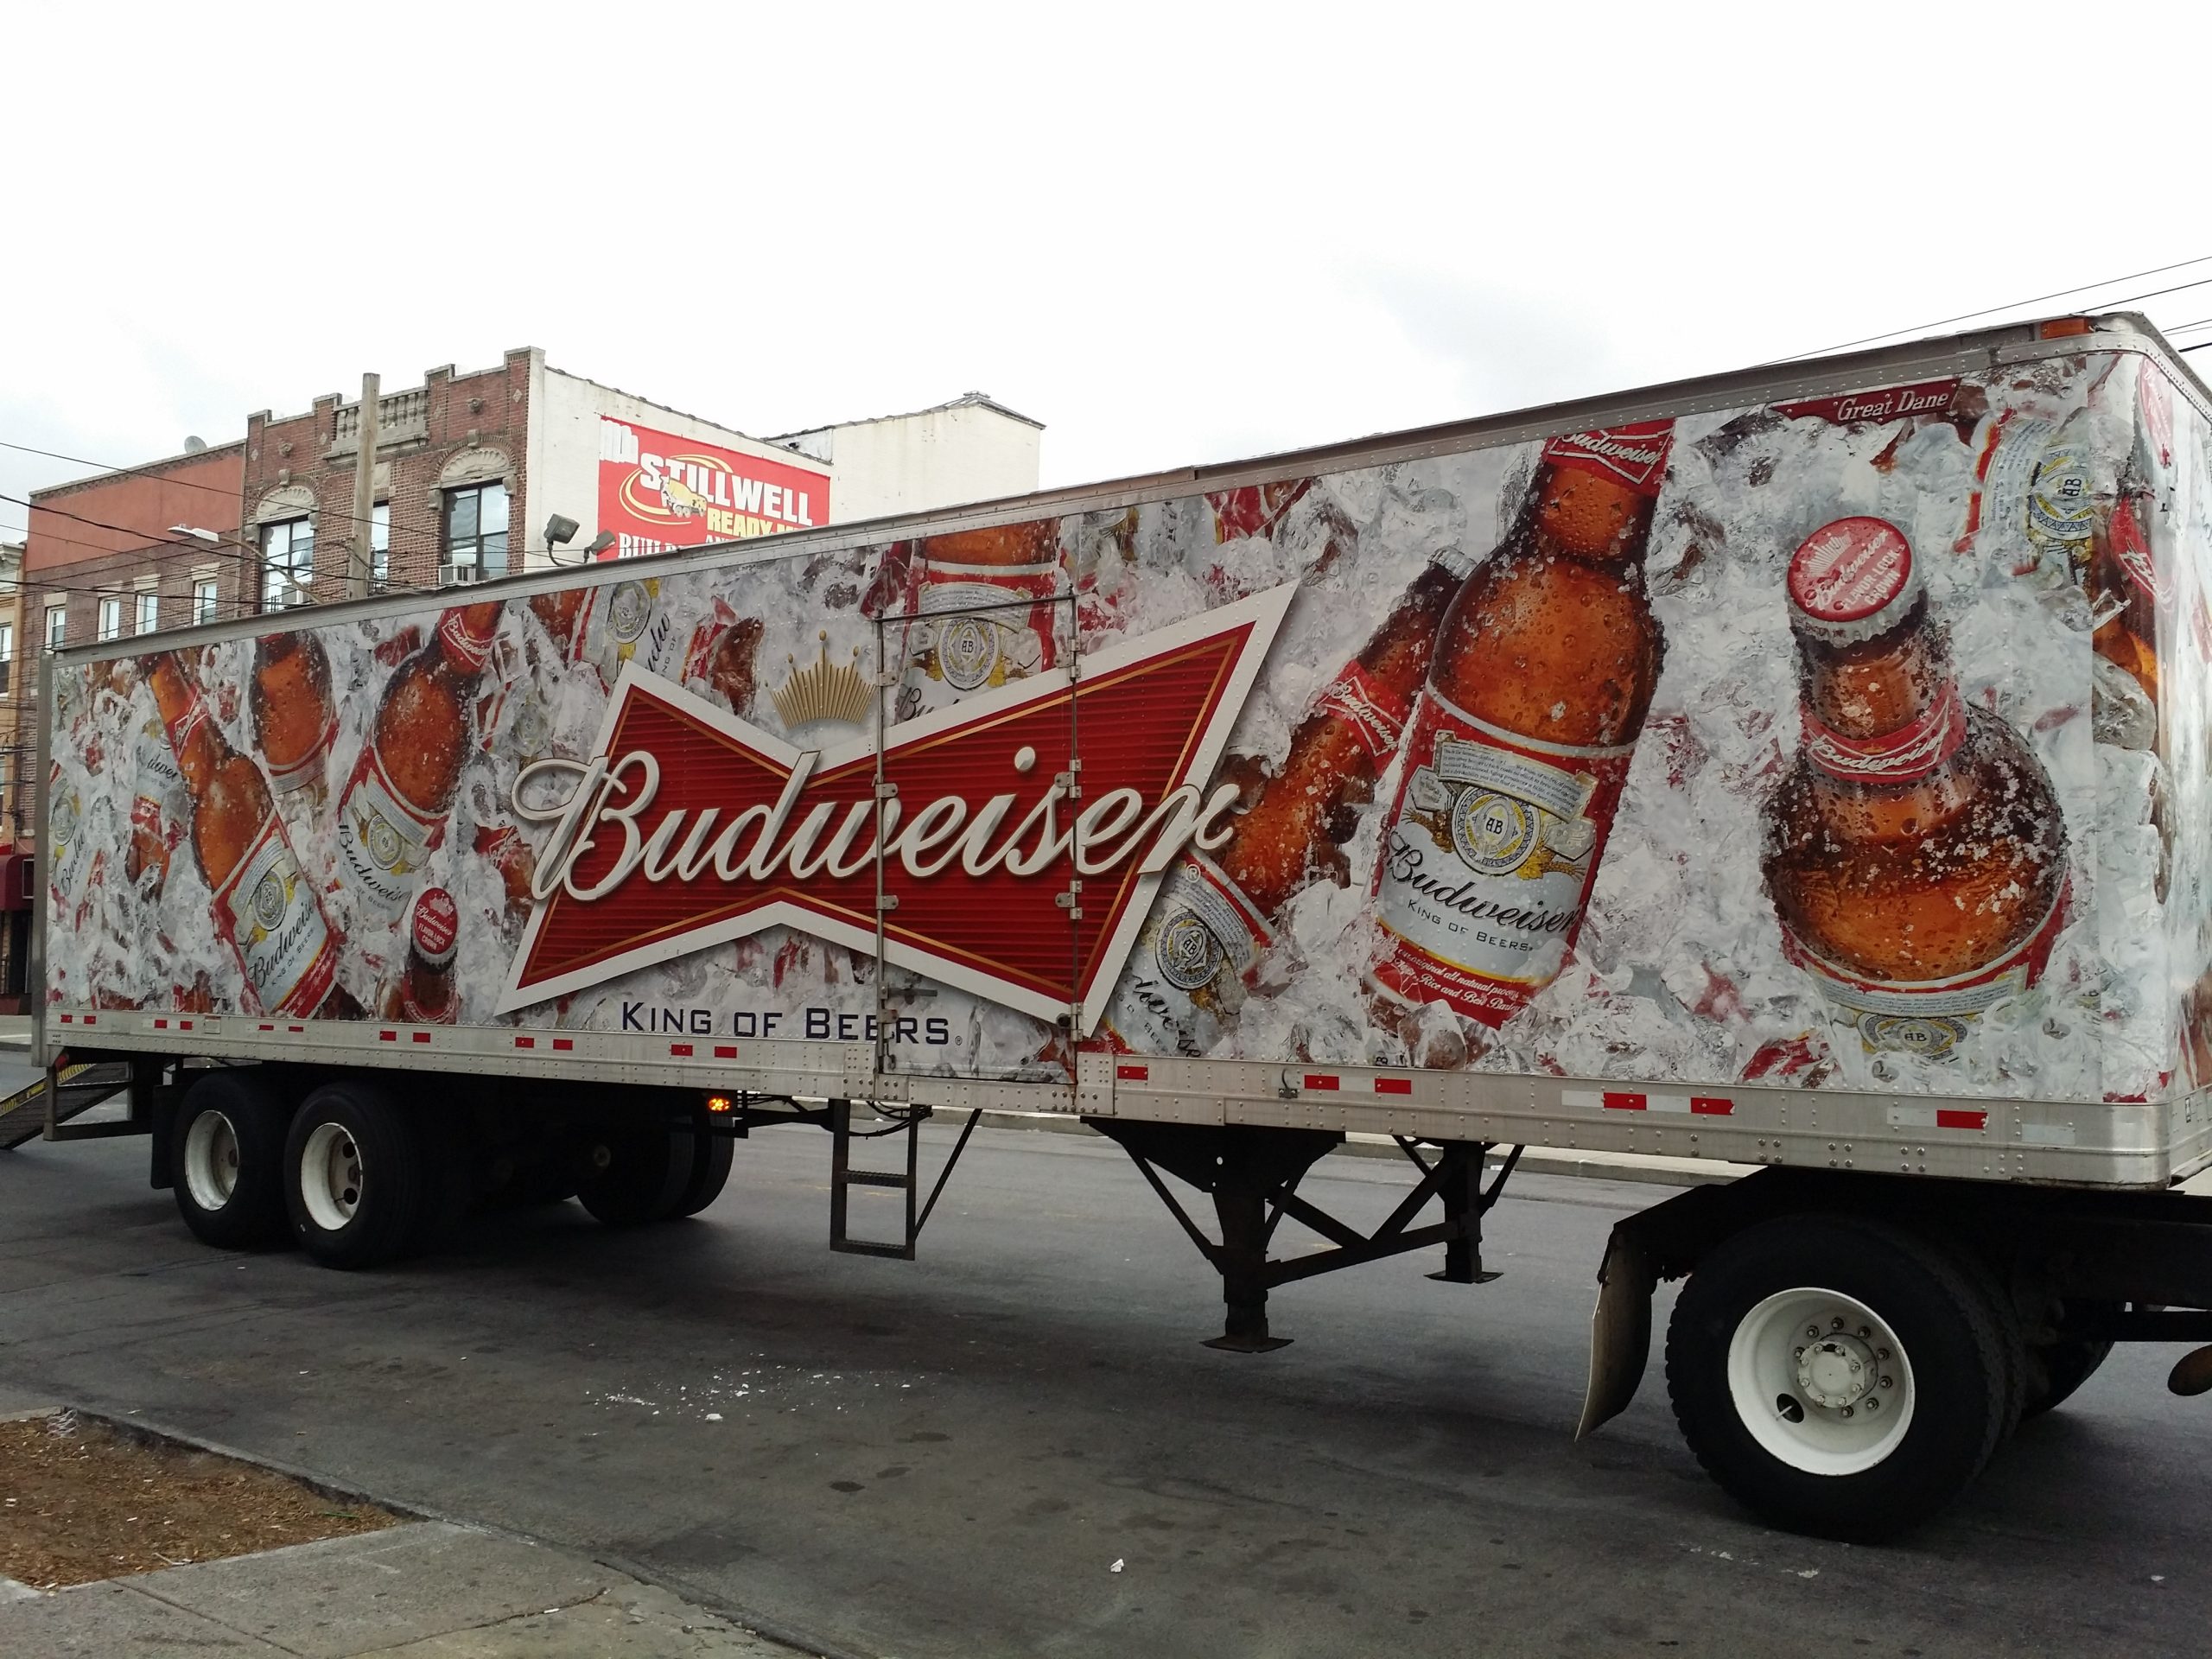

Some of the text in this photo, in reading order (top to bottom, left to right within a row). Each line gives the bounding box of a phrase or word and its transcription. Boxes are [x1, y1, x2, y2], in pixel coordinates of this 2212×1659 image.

[1837, 390, 1949, 422] Great Dane
[639, 452, 813, 527] STILLWELL
[707, 507, 774, 538] READY
[1331, 681, 1398, 750] Budweiser
[512, 746, 1242, 901] Budweiser
[339, 824, 412, 902] Budweis
[1389, 830, 1583, 934] Budweiser
[247, 899, 315, 988] Budweis
[416, 903, 453, 936] Budweiser
[1408, 899, 1529, 951] KING OF BEERS
[1419, 973, 1441, 990] Rice
[1440, 985, 1463, 999] and
[1443, 970, 1460, 982] all
[1456, 976, 1493, 995] natural
[622, 1001, 949, 1046] KING OF BEERS
